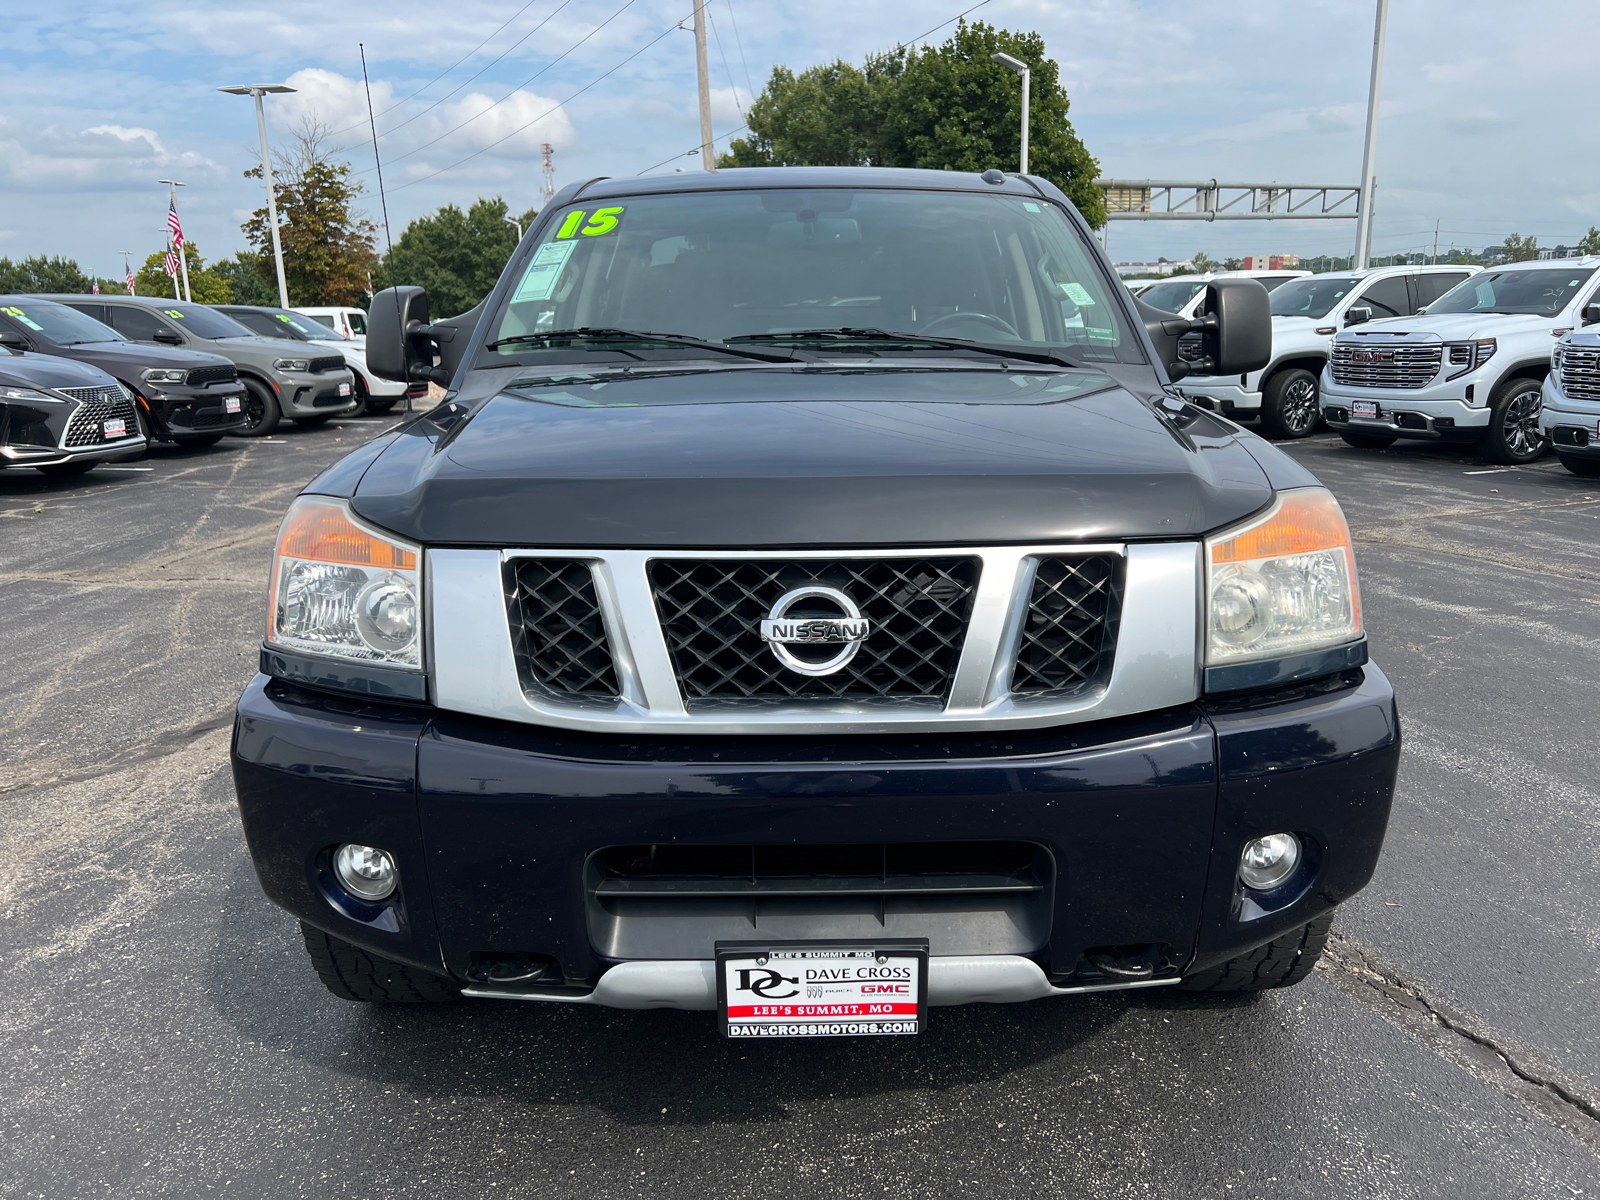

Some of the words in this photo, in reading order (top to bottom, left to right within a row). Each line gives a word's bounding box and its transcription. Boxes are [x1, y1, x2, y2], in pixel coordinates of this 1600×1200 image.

[556, 206, 625, 239] 15
[0, 306, 26, 317] 24
[164, 309, 185, 319] 23
[1353, 351, 1393, 362] GMC
[772, 624, 857, 638] NISSAN
[805, 951, 850, 959] SUMMIT
[806, 968, 851, 980] DAVE
[856, 967, 911, 979] CROSS
[735, 968, 800, 999] DC
[861, 984, 909, 993] GMC
[753, 1006, 792, 1015] LEE'S
[797, 1005, 863, 1015] SUMMIT,
[869, 1004, 893, 1013] MO
[730, 1023, 915, 1036] DAVECROSSMOTORS.COM
